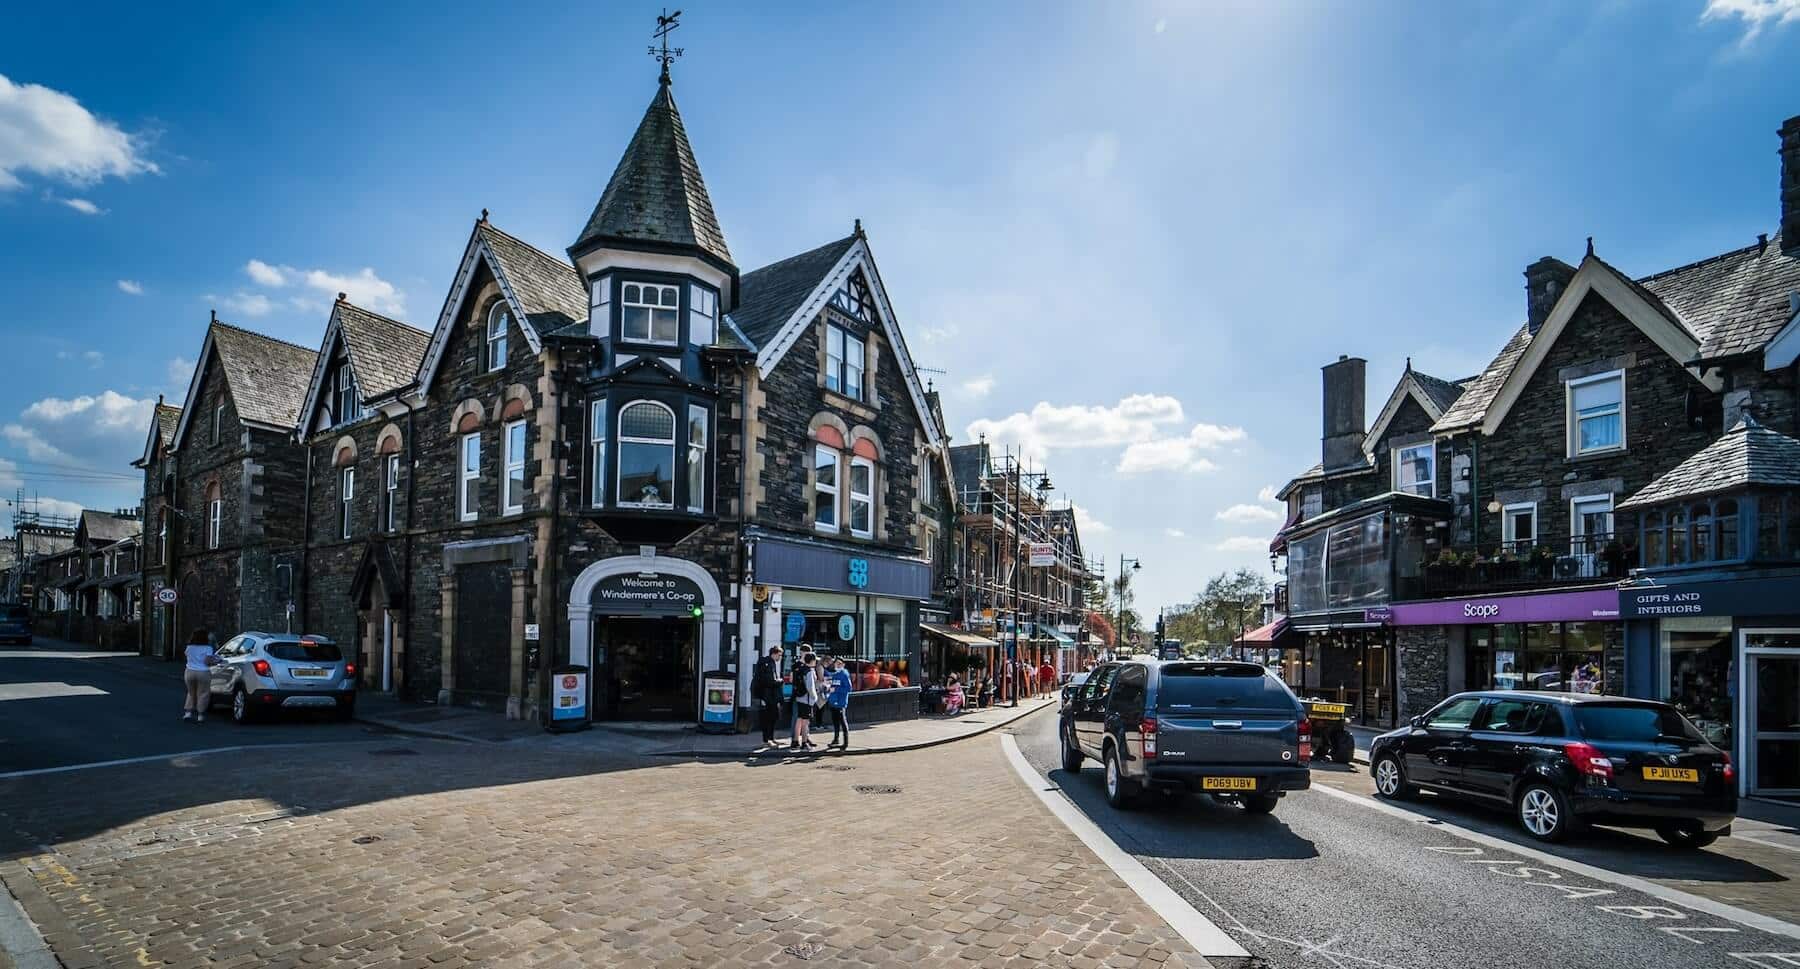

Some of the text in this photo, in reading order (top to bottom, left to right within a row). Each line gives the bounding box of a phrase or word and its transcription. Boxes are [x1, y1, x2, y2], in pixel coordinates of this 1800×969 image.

[621, 578, 676, 588] Welcome to
[602, 589, 695, 602] Windermere's Co-op
[1637, 593, 1700, 603] GIFTS AND
[1464, 603, 1498, 618] Scope
[1638, 604, 1702, 615] INTERIORS
[1671, 769, 1690, 779] UXS
[1207, 779, 1251, 788] PO69 UBV
